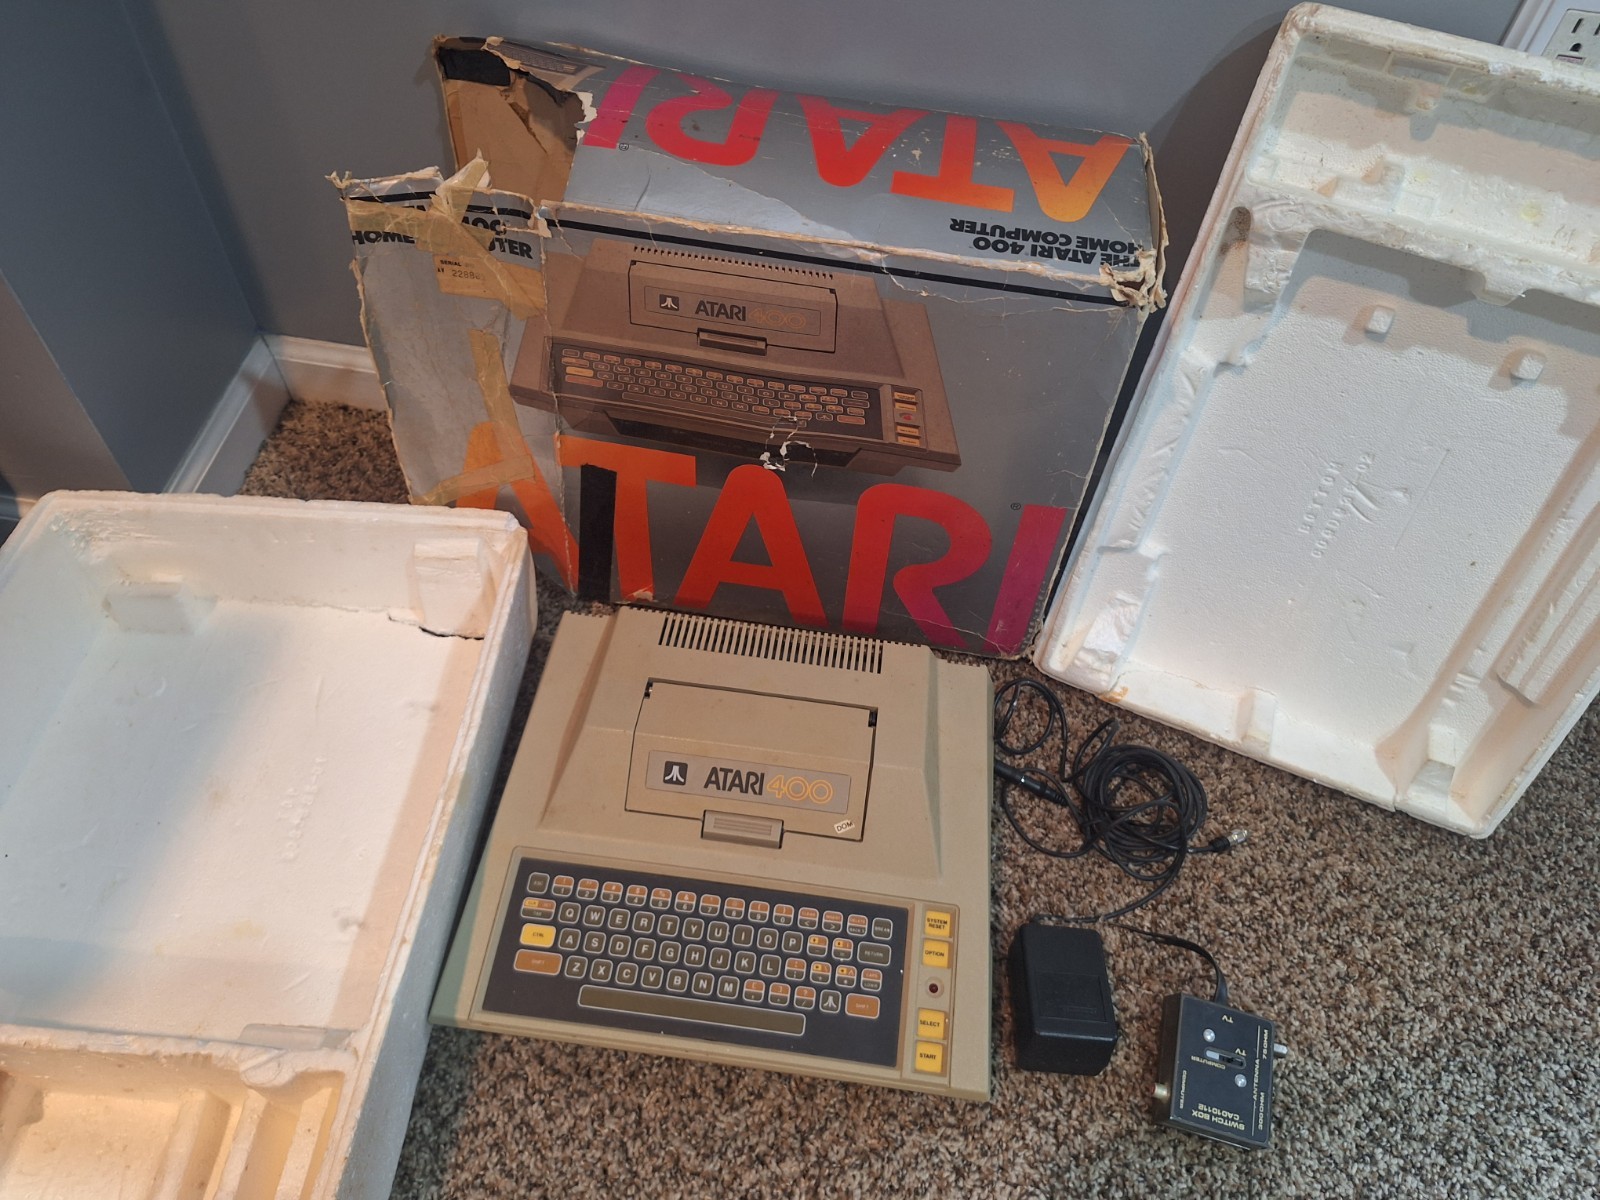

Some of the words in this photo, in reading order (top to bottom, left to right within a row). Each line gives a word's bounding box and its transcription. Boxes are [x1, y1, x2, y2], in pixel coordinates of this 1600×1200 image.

[583, 65, 1131, 222] ATARI
[950, 218, 1072, 247] COMPUTER
[972, 236, 1025, 255] 400
[1076, 235, 1140, 254] HOME
[1030, 245, 1096, 265] ATARI
[1100, 252, 1139, 267] THE
[695, 300, 746, 322] ATARI
[750, 308, 807, 329] 400
[455, 421, 1067, 657] ATARI
[703, 766, 765, 796] ATARI
[766, 775, 834, 804] 400
[565, 908, 574, 918] Q
[590, 911, 600, 920] W
[615, 914, 623, 924] E
[640, 917, 648, 927] R
[665, 921, 673, 930] T
[690, 925, 698, 934] Y
[714, 928, 722, 937] U
[763, 935, 772, 944] O
[789, 938, 796, 947] P
[864, 950, 883, 958] RETURN
[565, 935, 573, 944] A
[591, 938, 599, 947] S
[616, 941, 624, 950] D
[641, 945, 649, 954] F
[666, 948, 674, 957] G
[691, 951, 699, 961] H
[716, 955, 723, 964] J
[741, 958, 749, 967] K
[767, 962, 774, 971] L
[572, 962, 580, 972] Z
[597, 965, 606, 975] X
[623, 969, 631, 978] C
[649, 972, 657, 982] V
[674, 975, 681, 985] B
[699, 979, 707, 989] N
[724, 982, 733, 992] M
[919, 1020, 940, 1028] SELECT
[1222, 1014, 1234, 1024] TV
[919, 1052, 936, 1060] START
[1235, 1047, 1247, 1057] TV
[1190, 1055, 1226, 1070] COMPUTER
[1179, 1070, 1187, 1109] COMPUTER
[1192, 1109, 1211, 1122] BOX
[1212, 1116, 1246, 1131] SWITCH
